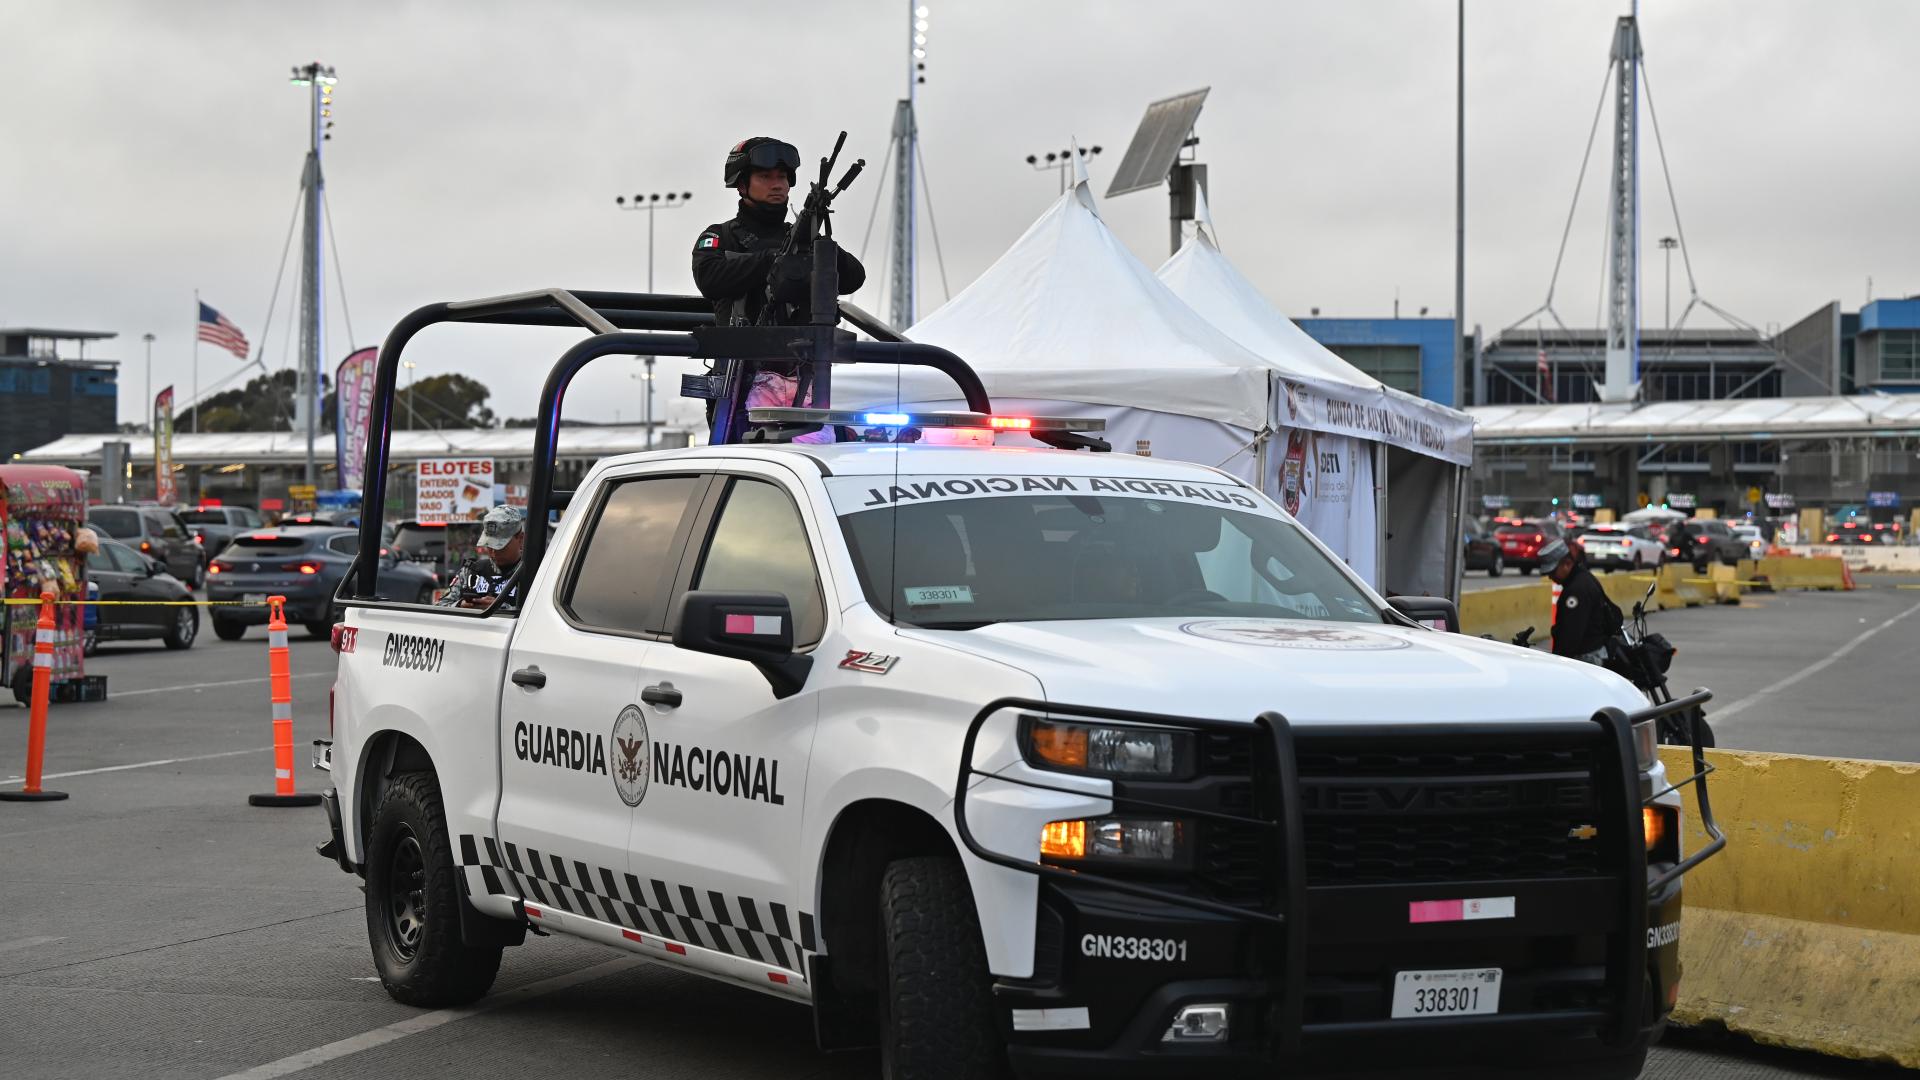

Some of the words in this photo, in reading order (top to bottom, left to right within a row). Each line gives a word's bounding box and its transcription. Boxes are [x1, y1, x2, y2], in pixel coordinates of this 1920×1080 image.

[1327, 398, 1353, 428] PUNTO
[1355, 404, 1365, 430] DE
[420, 461, 492, 475] ELOTES
[420, 479, 459, 488] ENTEROS
[420, 490, 454, 499] ASADOS
[420, 501, 442, 511] VASO
[919, 590, 958, 601] 338301
[341, 629, 359, 651] 911
[382, 632, 445, 673] GN338301
[514, 720, 607, 776] GUARDIA
[653, 741, 784, 806] NACIONAL
[1081, 933, 1187, 961] GN338301
[1414, 986, 1479, 1013] 338301
